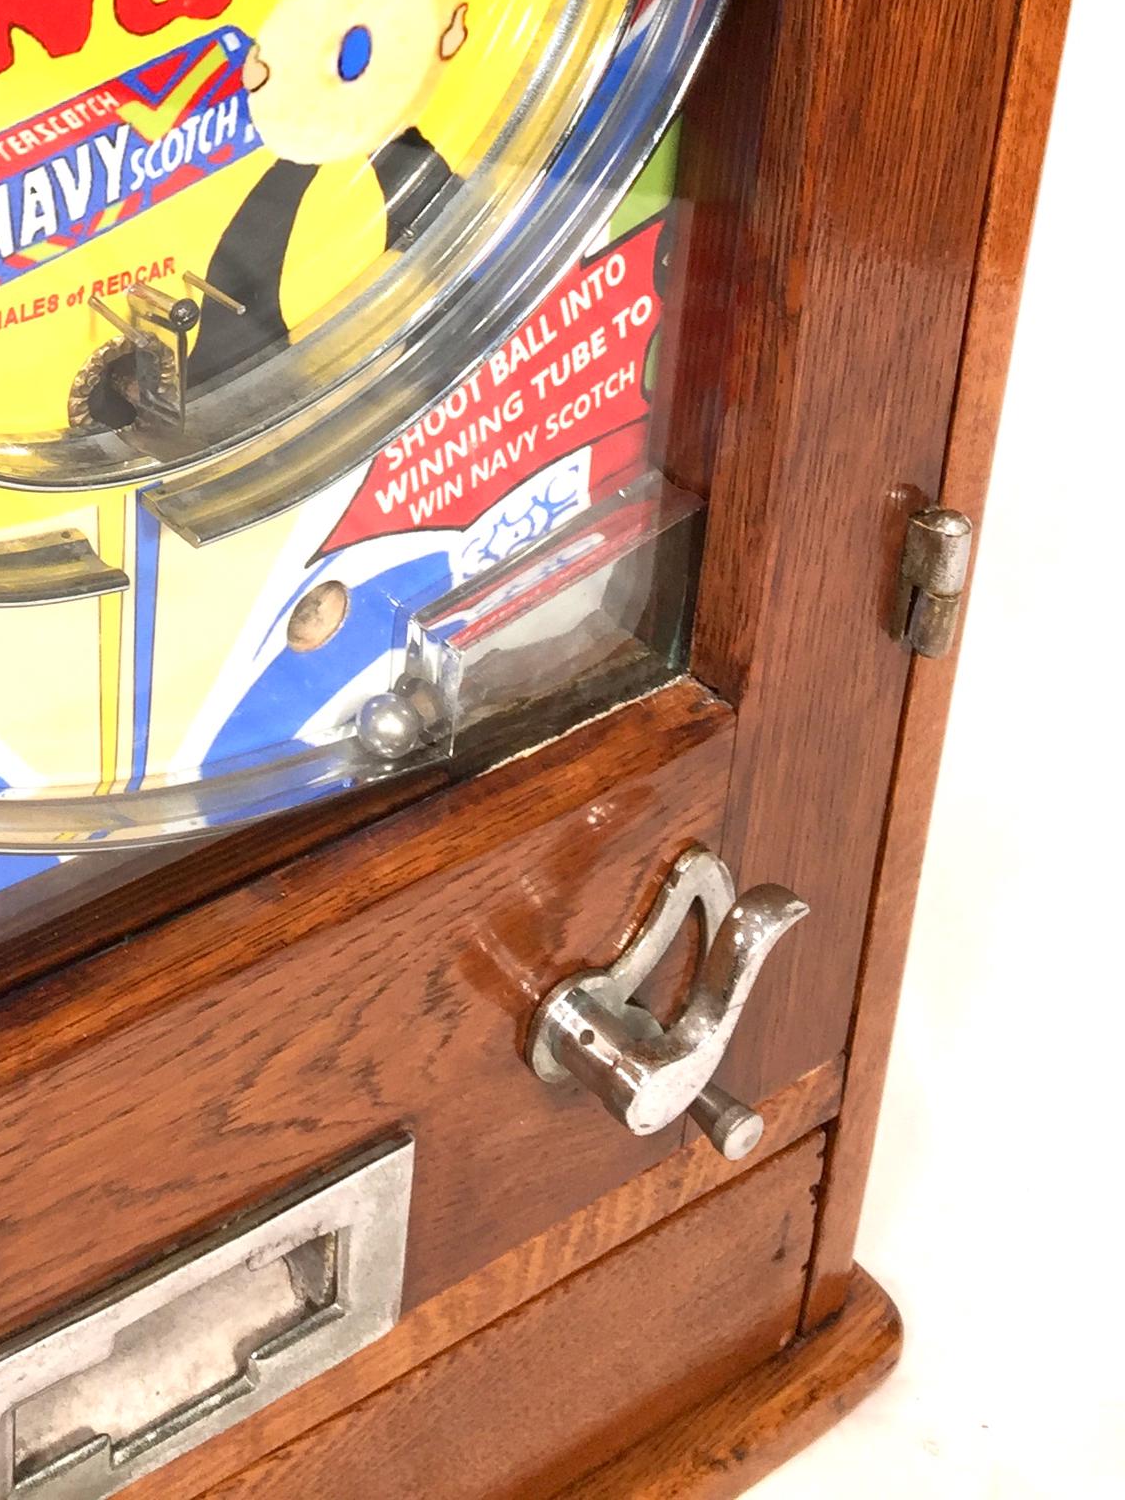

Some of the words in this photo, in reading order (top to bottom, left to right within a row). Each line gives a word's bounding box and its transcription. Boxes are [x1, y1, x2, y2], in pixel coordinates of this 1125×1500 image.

[129, 96, 238, 191] SCOTCH
[66, 286, 86, 308] of
[92, 256, 176, 300] REDCAR
[384, 371, 484, 471] SHOOT
[488, 313, 558, 386] BALL
[559, 253, 626, 328] INTO
[375, 390, 525, 514] WINNING
[530, 327, 607, 399] TUBE
[612, 295, 652, 338] TO
[408, 472, 463, 525] WIN
[471, 425, 539, 488] NAVY
[545, 361, 635, 440] SCOTCH
